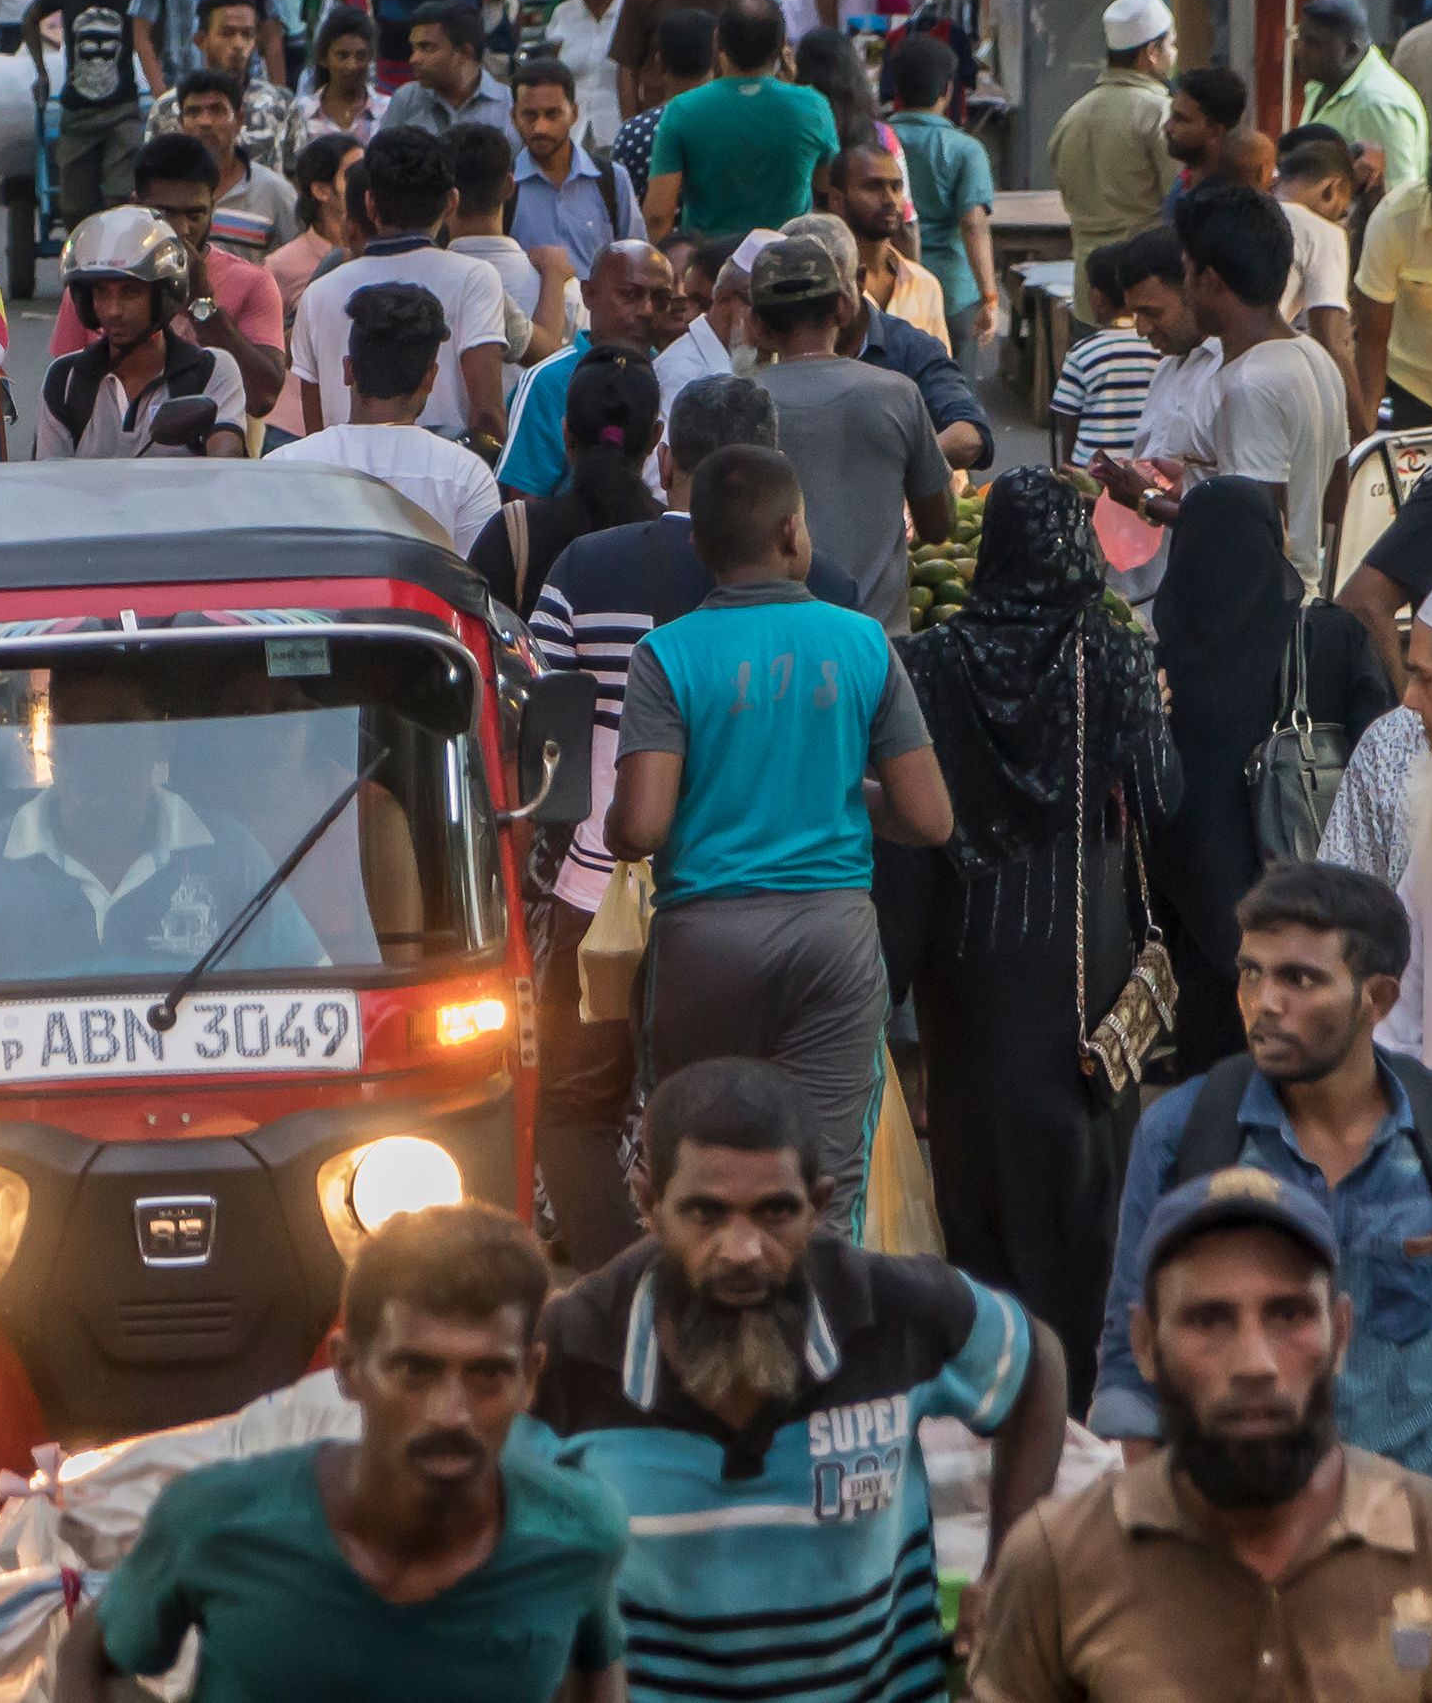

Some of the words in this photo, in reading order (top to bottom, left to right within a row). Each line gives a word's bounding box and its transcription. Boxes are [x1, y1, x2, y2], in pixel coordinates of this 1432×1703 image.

[41, 1007, 165, 1067] ABN
[193, 995, 352, 1061] 3049
[808, 1396, 909, 1459] SUPER
